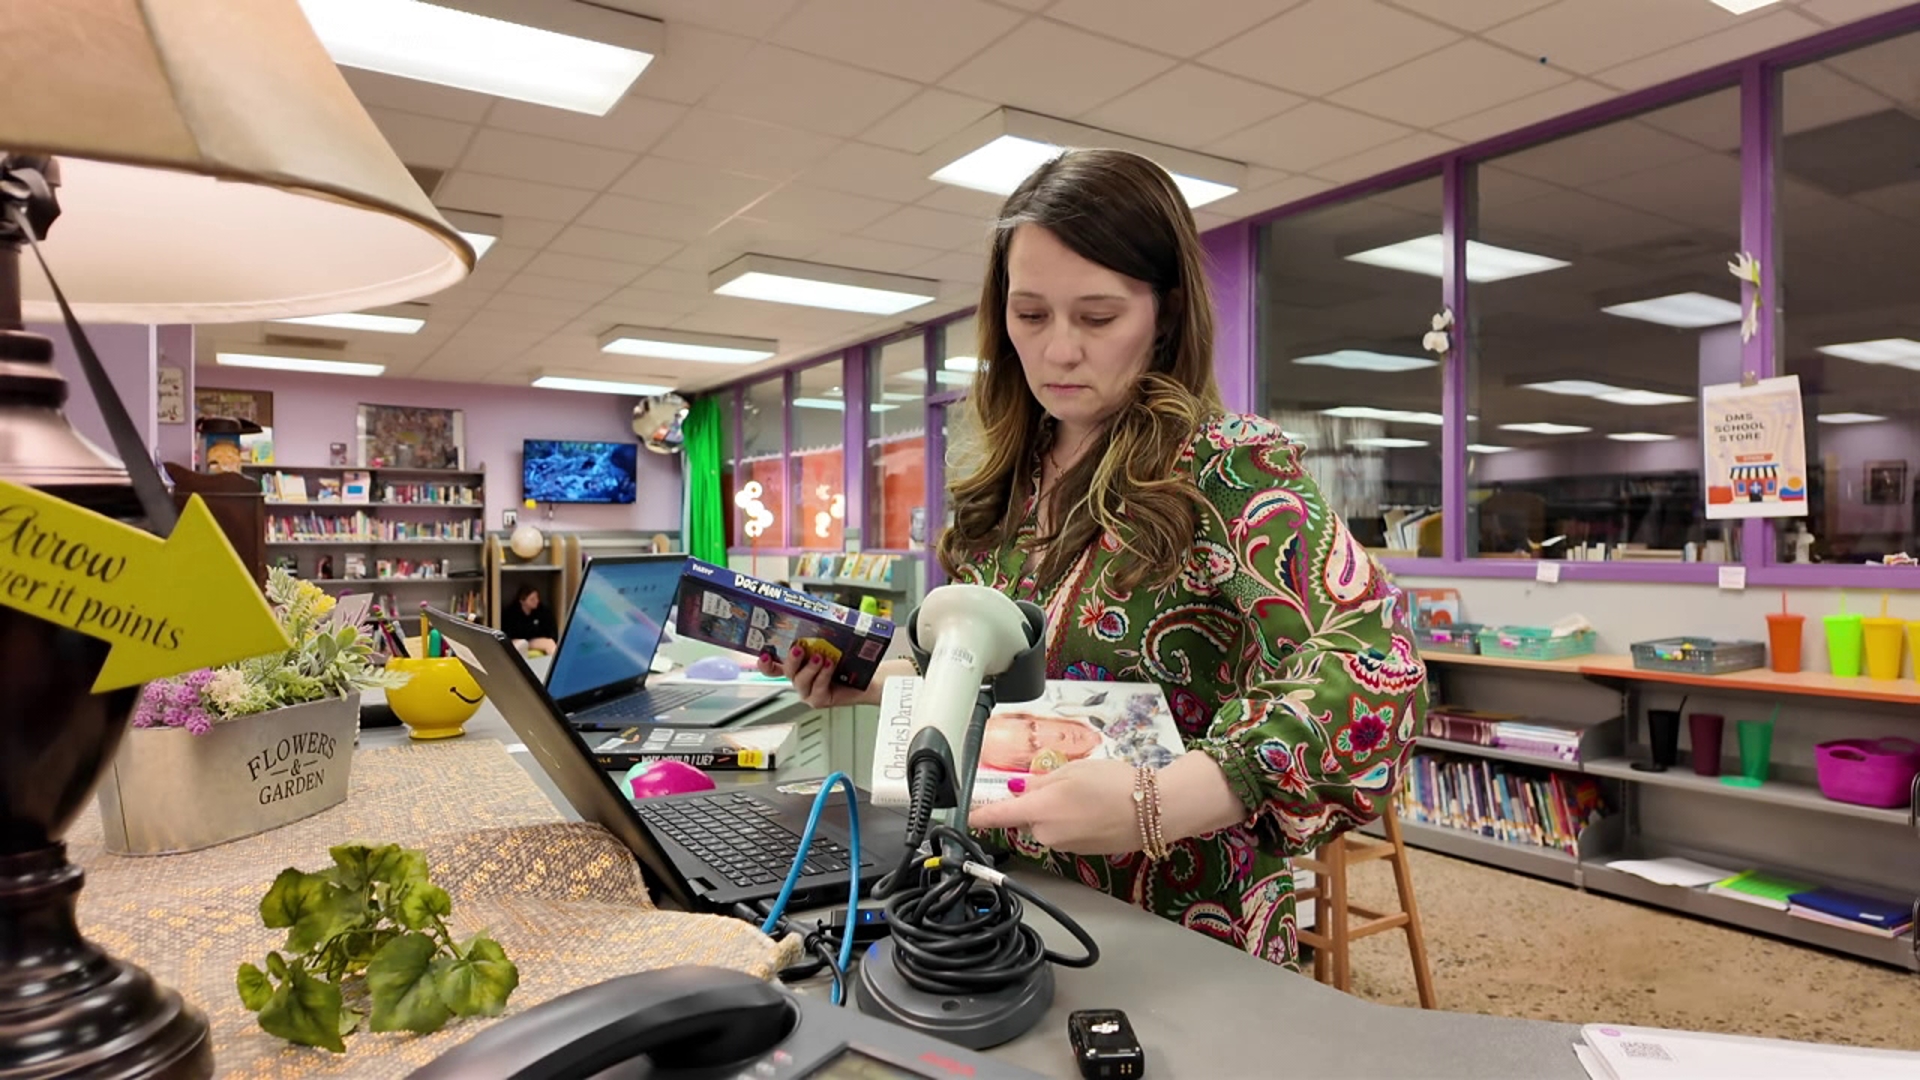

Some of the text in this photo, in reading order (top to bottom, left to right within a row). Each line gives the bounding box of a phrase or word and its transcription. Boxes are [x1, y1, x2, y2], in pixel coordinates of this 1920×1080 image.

[1714, 423, 1764, 433] SCHOOL
[1725, 413, 1753, 422] DMS
[1719, 432, 1760, 442] STORE
[0, 504, 126, 583] Arrow
[734, 573, 759, 593] DOG
[758, 583, 782, 600] MAN
[47, 580, 77, 615] it
[75, 596, 184, 651] points
[890, 678, 914, 727] Darwin
[247, 731, 337, 782] FLOWERS
[290, 758, 301, 777] &
[884, 727, 911, 781] Charles
[259, 768, 325, 805] GARDEN
